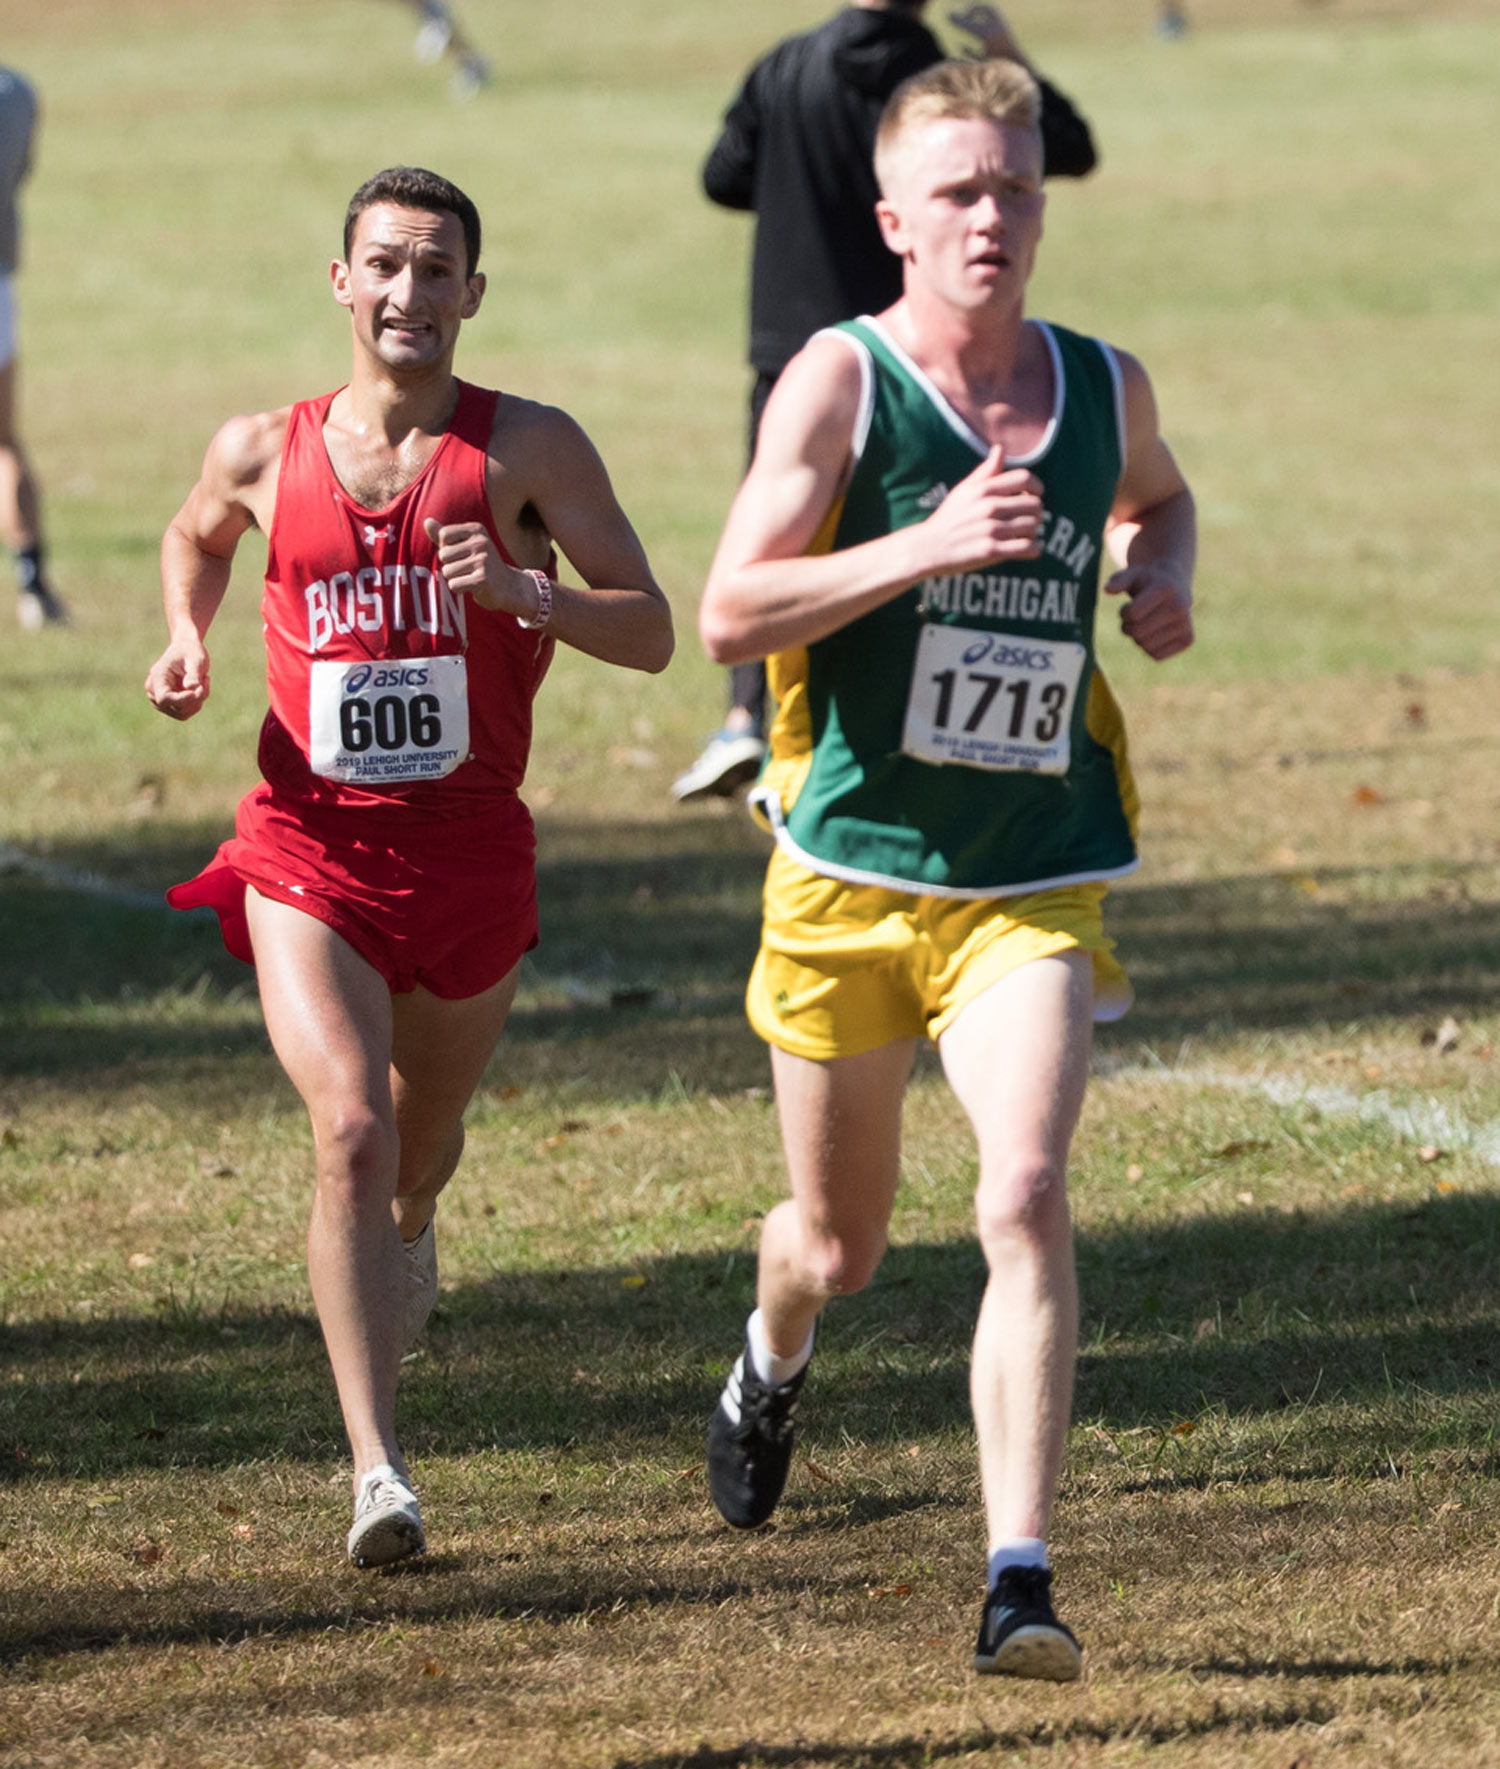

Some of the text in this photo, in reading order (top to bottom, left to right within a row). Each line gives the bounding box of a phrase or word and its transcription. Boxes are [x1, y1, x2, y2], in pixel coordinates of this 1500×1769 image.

[305, 564, 468, 654] BOSTON
[920, 573, 1081, 623] MICHIGAN
[993, 645, 1054, 671] asics
[373, 668, 429, 687] asics
[339, 693, 442, 753] 606
[931, 667, 1067, 743] 1713
[336, 749, 459, 767] 2019 LEHIGH UNIVERSITY
[355, 761, 442, 776] PAUL SHORT RUN
